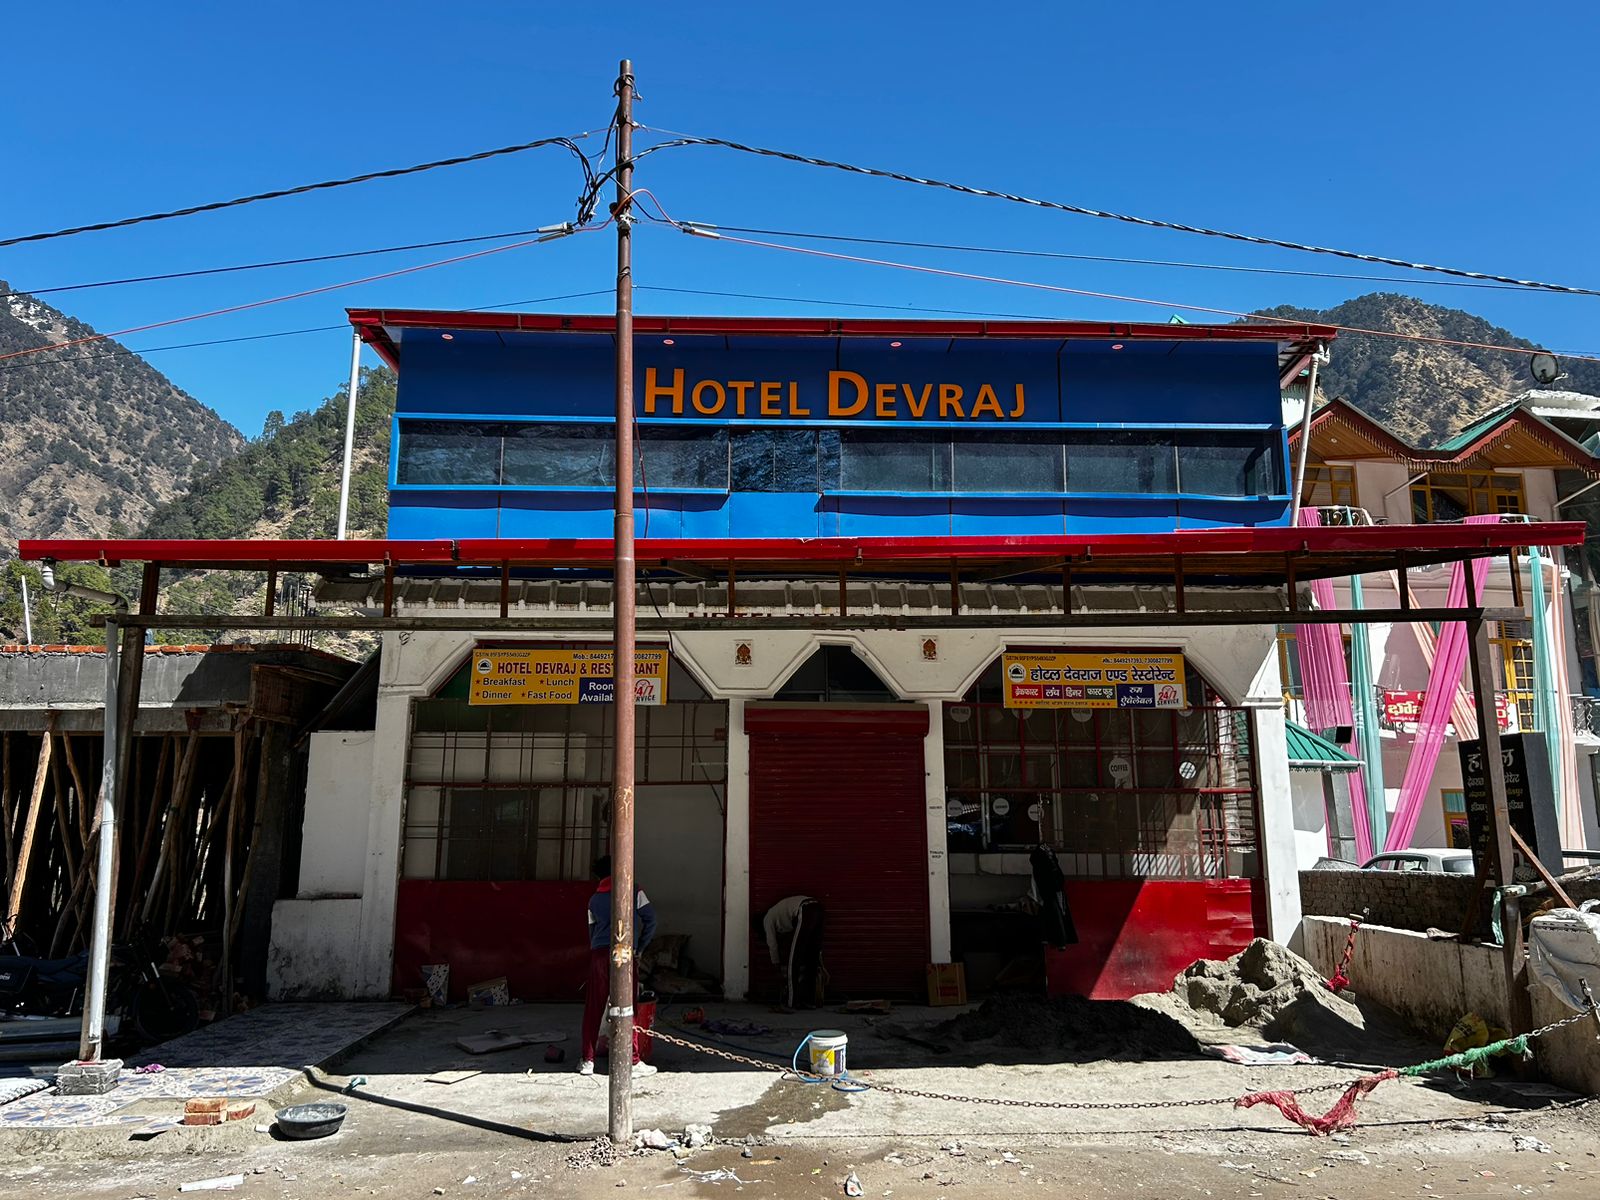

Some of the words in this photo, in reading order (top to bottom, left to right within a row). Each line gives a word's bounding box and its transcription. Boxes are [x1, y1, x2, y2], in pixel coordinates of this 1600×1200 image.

[644, 367, 811, 416] HOTEL
[828, 370, 1025, 419] DEVRAJ
[497, 662, 532, 674] HOTEL
[535, 662, 577, 674] DEVRAJ
[580, 662, 587, 674] &
[1030, 664, 1061, 681] होटल
[1063, 664, 1102, 681] देवराज
[1105, 669, 1128, 681] एण्ड
[1131, 665, 1175, 681] रेस्टोरेन्ट
[483, 677, 526, 686] Breakfast
[546, 677, 574, 686] Lunch
[482, 690, 512, 699] Dinner
[527, 690, 547, 699] Fast
[549, 690, 572, 699] Food
[1045, 687, 1060, 697] लंच
[1158, 690, 1177, 700] 24/7
[1467, 746, 1515, 773] होल
[1110, 764, 1129, 772] COFFEE
